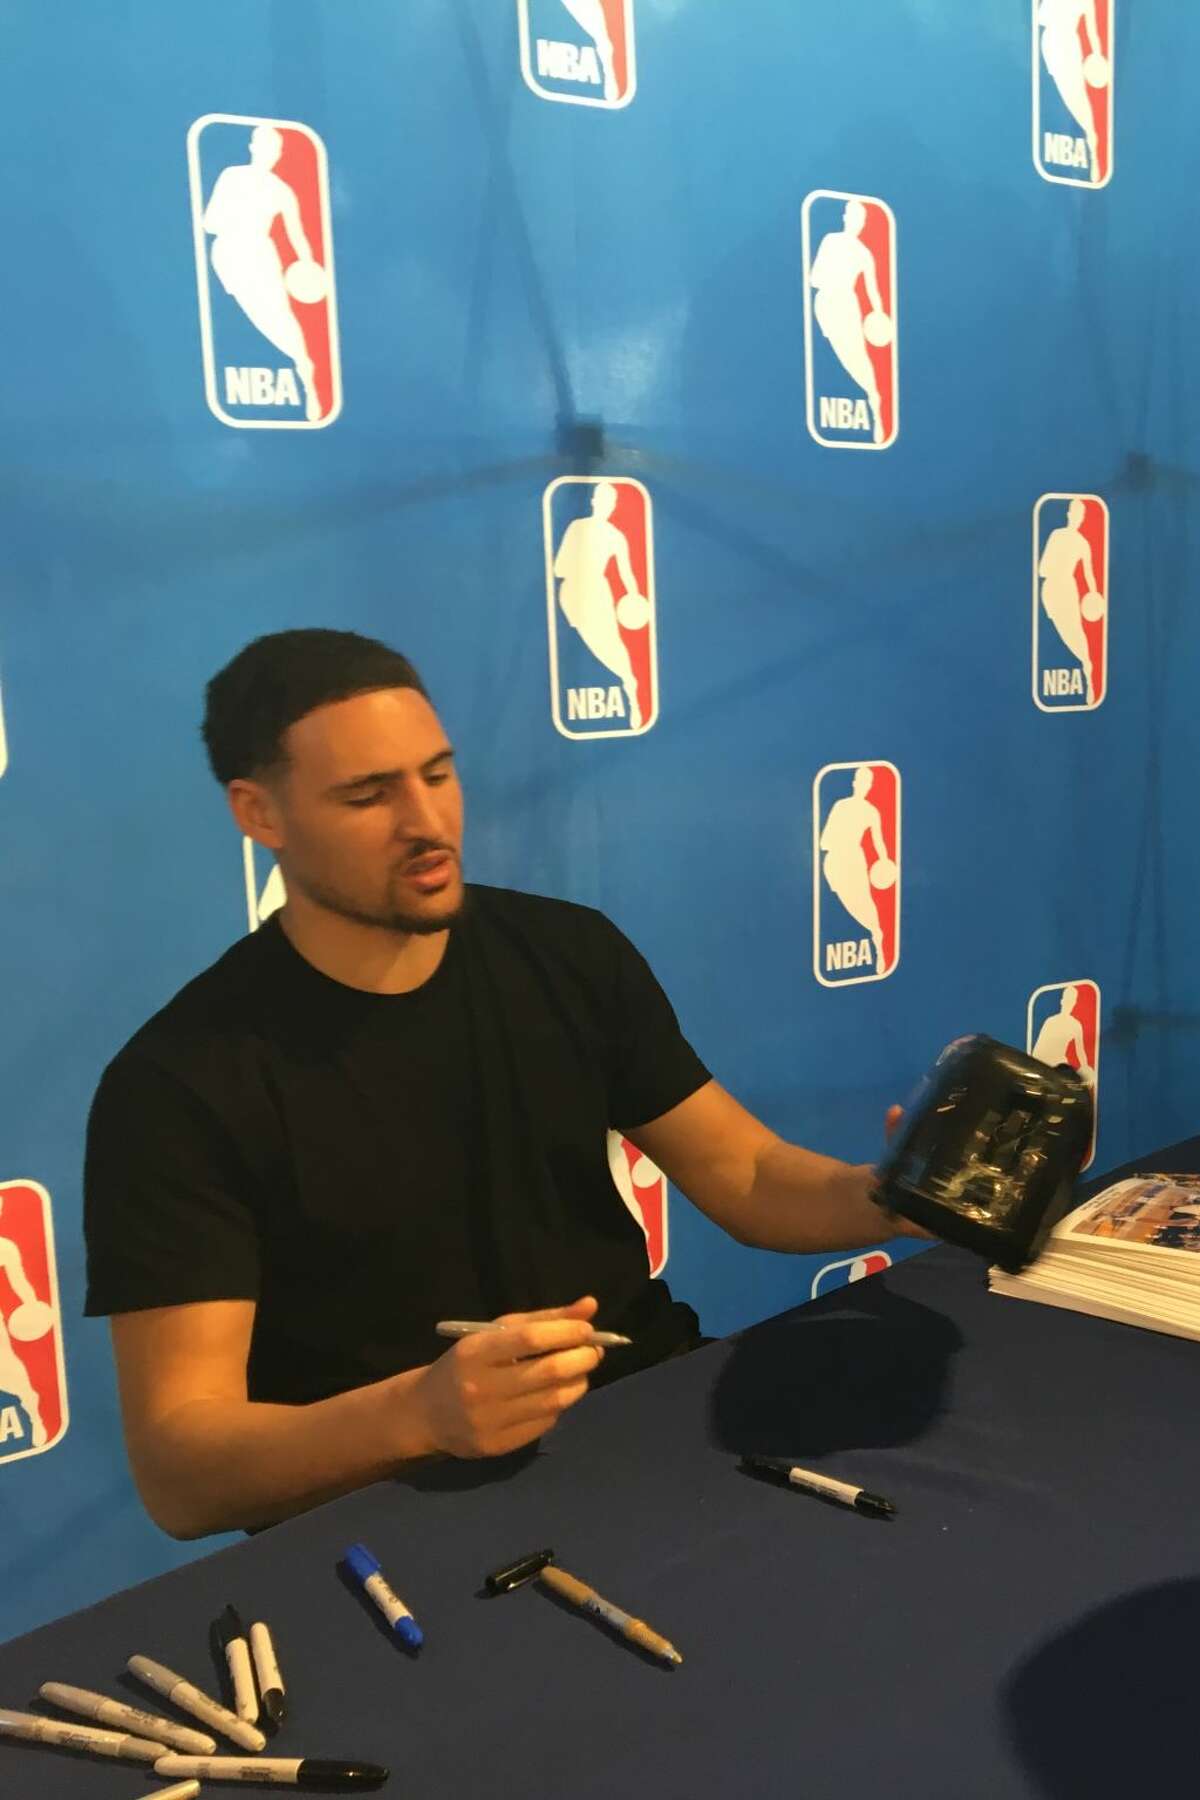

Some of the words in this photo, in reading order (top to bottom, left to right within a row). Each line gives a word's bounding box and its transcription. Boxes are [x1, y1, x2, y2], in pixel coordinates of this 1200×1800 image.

[537, 39, 601, 84] NBA
[1044, 132, 1088, 169] NBA
[225, 366, 301, 406] NBA
[820, 396, 871, 431] NBA
[1043, 668, 1084, 697] NBA
[566, 686, 625, 721] NBA
[826, 939, 873, 972] NBA
